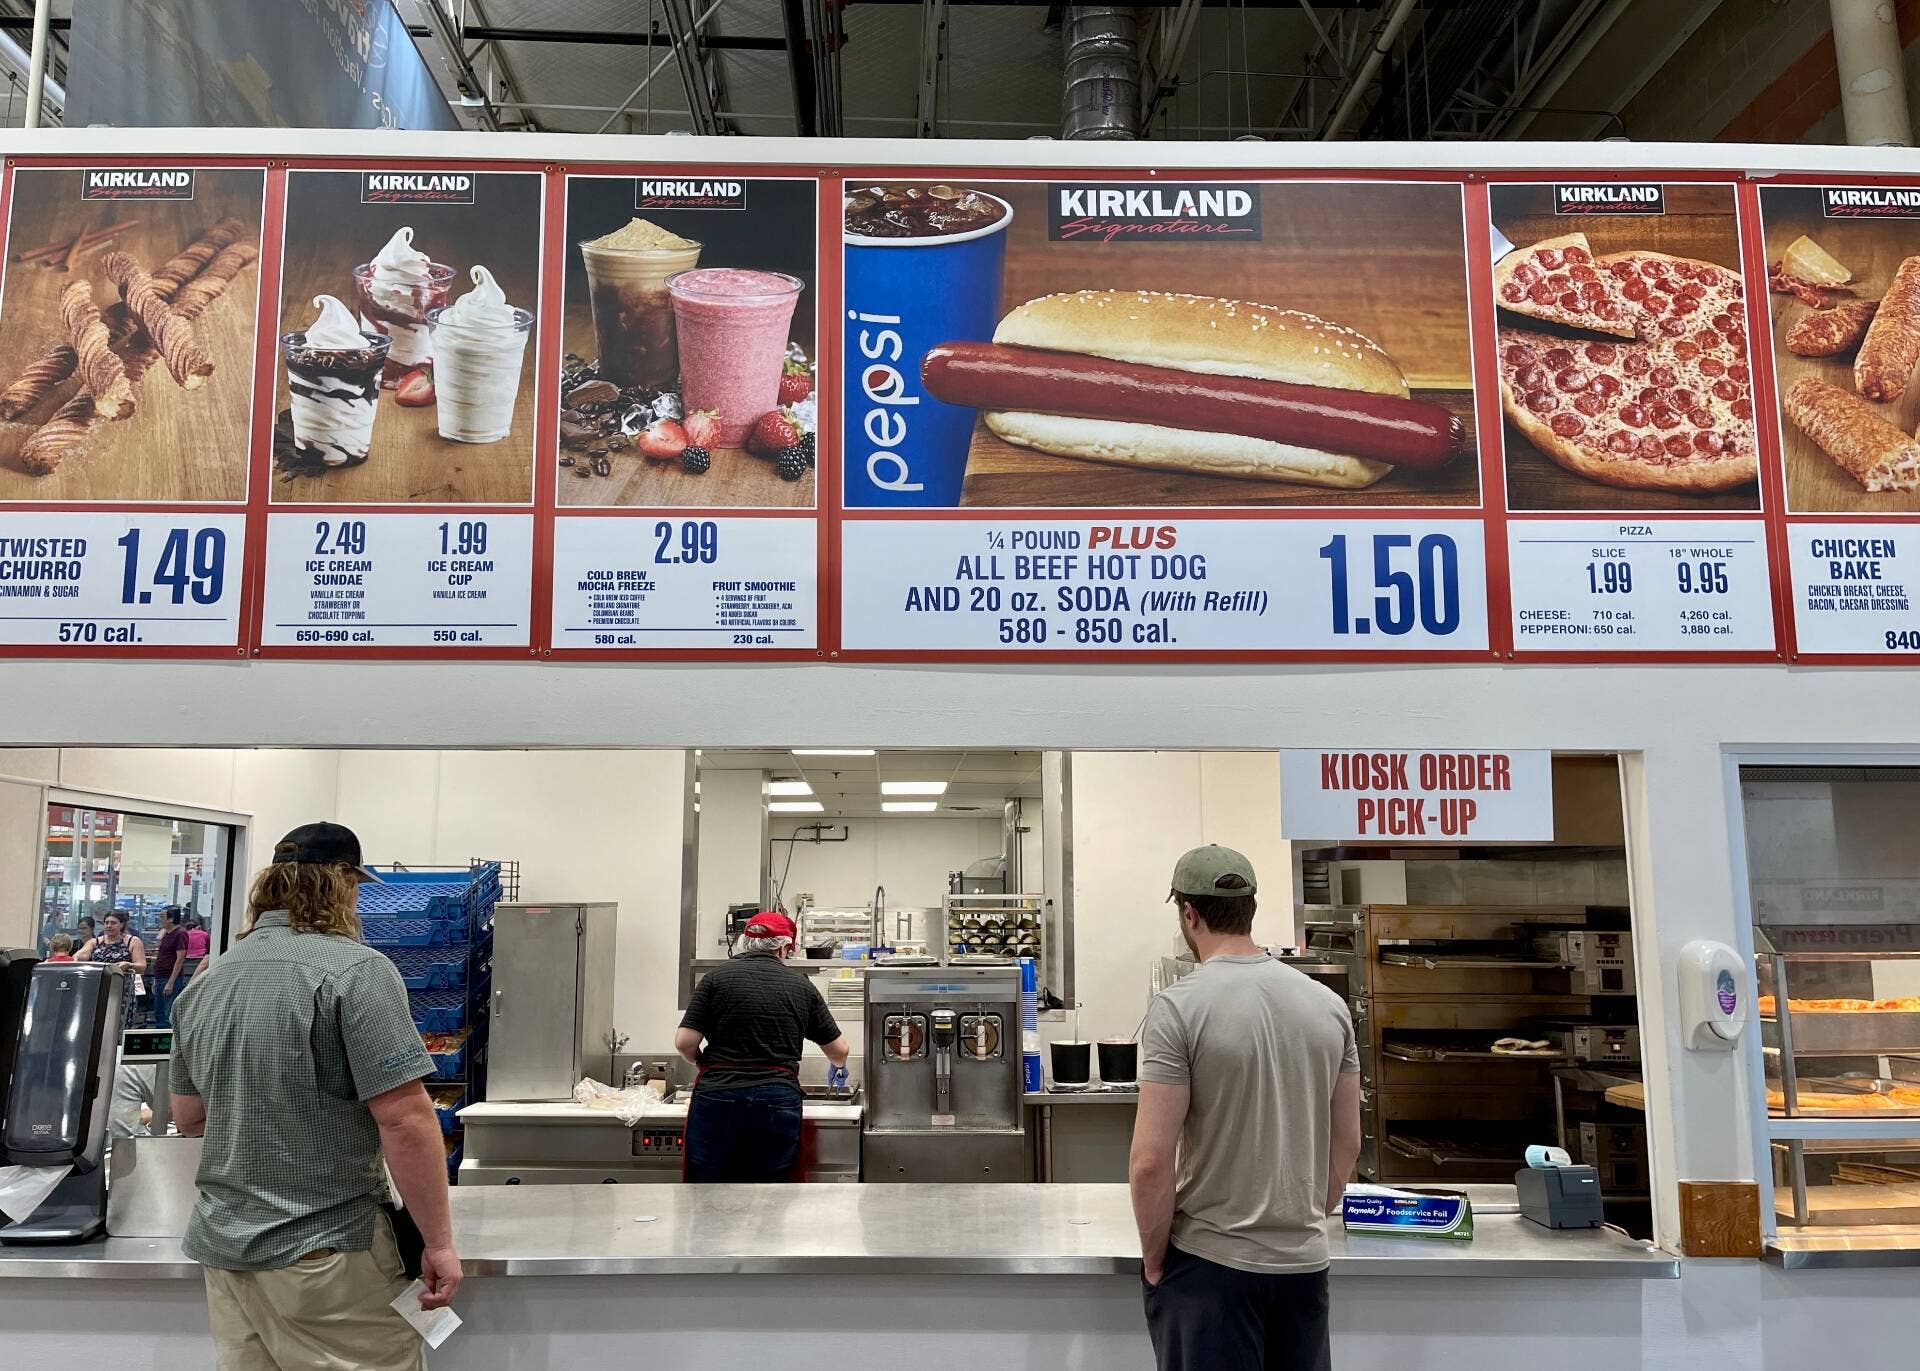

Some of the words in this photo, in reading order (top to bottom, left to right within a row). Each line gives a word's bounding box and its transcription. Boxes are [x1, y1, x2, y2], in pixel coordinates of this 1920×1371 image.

[89, 172, 190, 187] KIRKLAND
[368, 175, 470, 190] KIRKLAND
[89, 187, 190, 200] Signature
[642, 182, 741, 197] KIRKLAND
[1560, 188, 1659, 201] KIRKLAND
[368, 190, 469, 203] Signature
[642, 197, 740, 208] Signature
[1828, 191, 1920, 206] KIRKLAND
[1061, 190, 1252, 217] KIRKLAND
[1562, 202, 1658, 214] Signature
[1831, 205, 1920, 217] Signature
[1061, 217, 1255, 243] Signature
[848, 309, 924, 492] pepsi
[1619, 526, 1653, 536] PIZZA
[315, 521, 366, 555] 2.49
[438, 521, 487, 555] 1.99
[654, 521, 717, 564] 2.99
[1012, 530, 1080, 550] POUND
[1088, 526, 1177, 550] PLUS
[0, 538, 86, 558] TWISTED
[1592, 549, 1626, 558] SLICE
[1669, 549, 1687, 558] 18"
[1690, 549, 1733, 558] WHOLE
[1811, 539, 1896, 558] CHICKEN
[0, 561, 81, 580] CHURRO
[118, 528, 226, 604] 1.49
[306, 560, 325, 572] ICE
[329, 560, 372, 572] CREAM
[427, 560, 447, 572] ICE
[450, 560, 494, 572] CREAM
[956, 555, 1005, 580] ALL
[1015, 555, 1078, 580] BEEF
[1088, 555, 1141, 580] HOT
[1150, 555, 1206, 581] DOG
[1830, 561, 1881, 579] BAKE
[314, 574, 363, 586] SUNDAE
[448, 574, 472, 586] CUP
[587, 571, 613, 580] COLD
[616, 571, 647, 580] BREW
[1586, 562, 1633, 594] 1.99
[1677, 562, 1728, 594] 9.95
[44, 586, 49, 597] &
[53, 586, 79, 597] SUGAR
[578, 582, 614, 591] MOCHA
[618, 582, 656, 591] FREEZE
[712, 582, 741, 591] FRUIT
[744, 582, 796, 591] SMOOTHIE
[1318, 533, 1461, 637] 1.50
[1808, 585, 1841, 596] CHICKEN
[1843, 585, 1874, 598] BREAST,
[1876, 585, 1907, 598] CHEESE,
[433, 591, 455, 599] VANILLA
[457, 591, 466, 599] ICE
[467, 591, 487, 599] CREAM
[905, 586, 960, 612] AND
[970, 586, 1001, 612] 20
[1010, 592, 1046, 612] oz.
[1057, 586, 1130, 612] SODA
[1140, 590, 1197, 616] (With
[1203, 590, 1268, 616] Refill)
[314, 601, 351, 609] STRAWBERRY
[353, 601, 360, 609] OR
[1808, 599, 1838, 612] BACON,
[1840, 599, 1869, 610] CAESAR
[1871, 599, 1909, 610] DRESSING
[308, 611, 339, 619] CHOCOLATE
[341, 611, 365, 619] TOPPING
[1519, 611, 1571, 620] CHEESE:
[1593, 611, 1613, 620] 710
[1616, 610, 1635, 620] cal.
[1680, 610, 1709, 621] 4,260
[1712, 610, 1732, 620] cal.
[59, 623, 97, 642] 570
[104, 623, 143, 642] cal.
[296, 630, 348, 642] 650-690
[352, 630, 374, 642] cal.
[434, 630, 456, 642] 550
[460, 630, 482, 642] cal.
[1000, 618, 1047, 643] 580
[1076, 618, 1122, 643] 850
[1132, 618, 1177, 643] cal.
[1520, 625, 1592, 634] PEPPERONI:
[1594, 625, 1613, 634] 650
[1616, 625, 1636, 634] cal.
[1681, 625, 1710, 635] 3,880
[1713, 625, 1733, 634] cal.
[595, 635, 614, 644] 580
[618, 635, 636, 644] cal.
[733, 635, 753, 644] 230
[756, 635, 774, 644] cal.
[1885, 631, 1920, 649] 840
[1320, 753, 1408, 791] KIOSK
[1419, 754, 1512, 791] ORDER
[1357, 798, 1477, 836] PICK-UP
[1386, 1208, 1431, 1217] Foodservice
[1434, 1210, 1447, 1218] Foil
